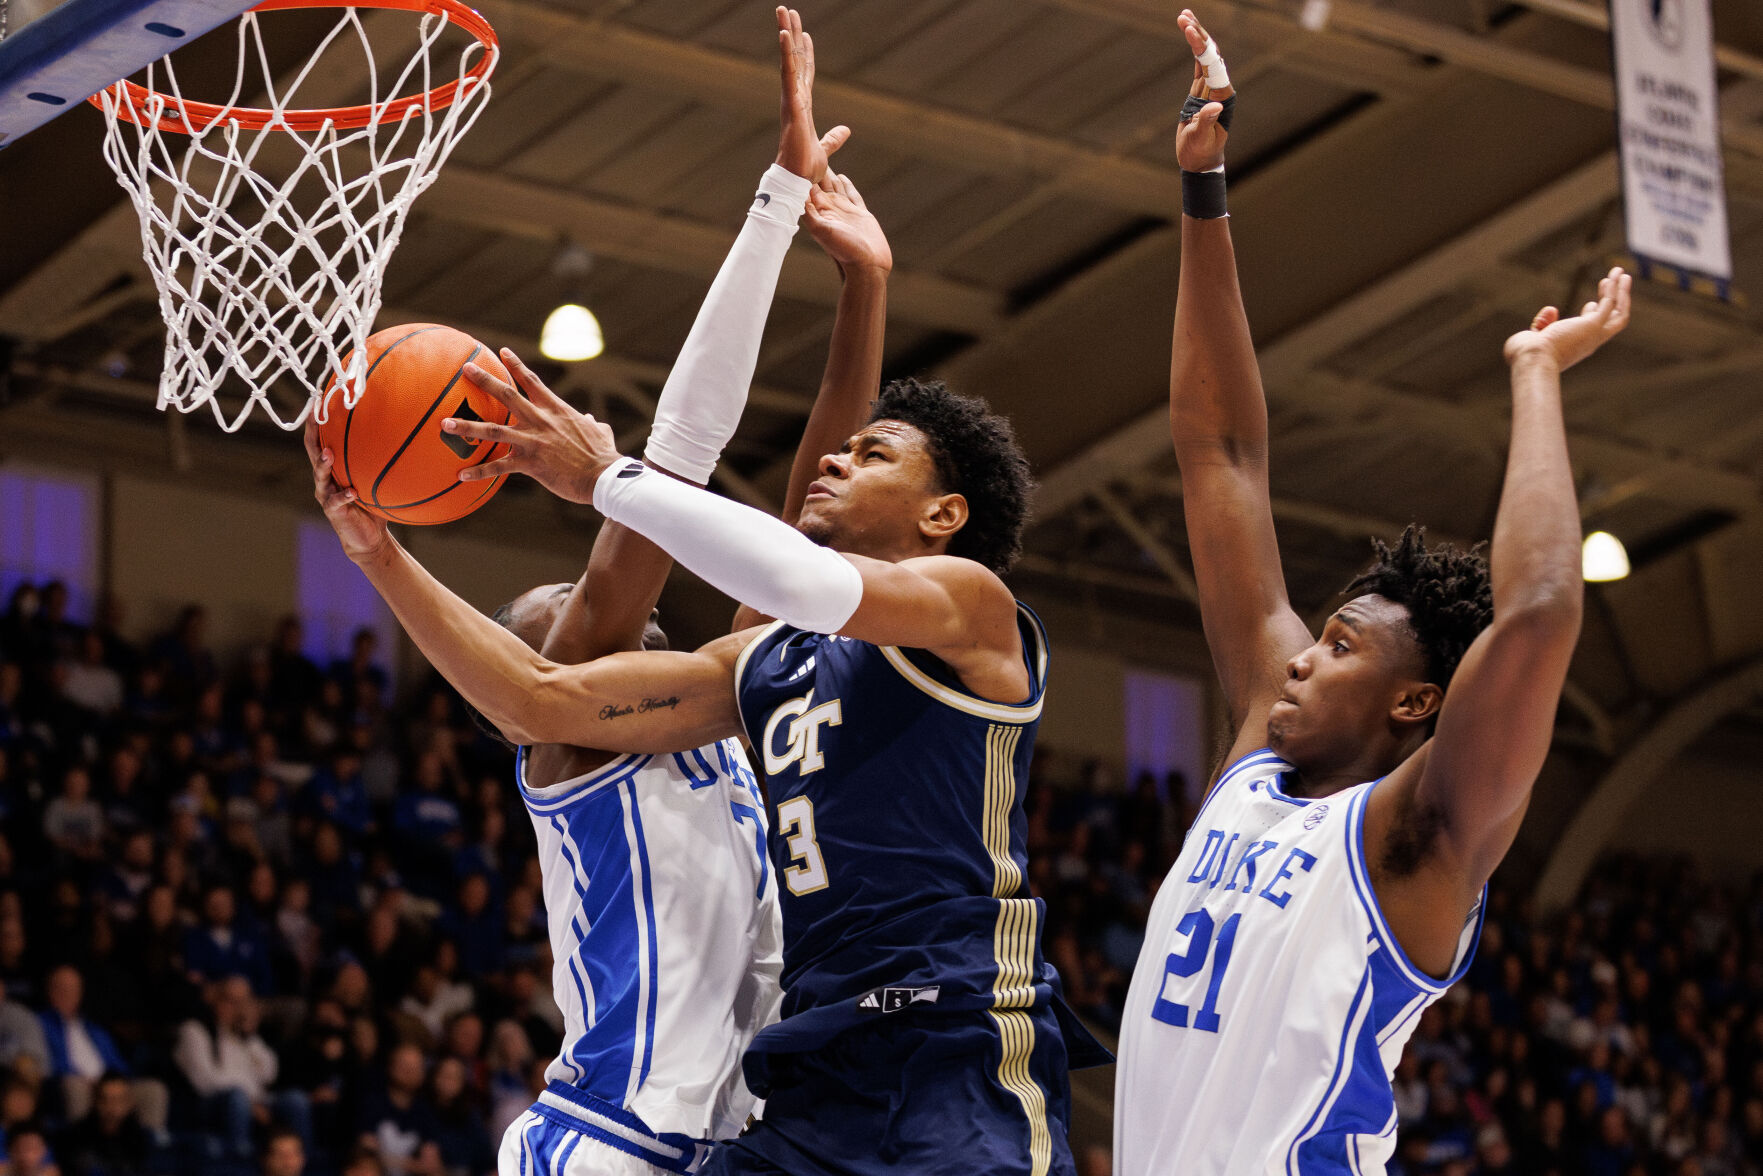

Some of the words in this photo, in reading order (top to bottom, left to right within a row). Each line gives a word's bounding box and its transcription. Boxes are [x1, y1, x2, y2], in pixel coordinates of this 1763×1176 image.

[730, 800, 768, 901] 7
[777, 795, 829, 897] 3
[894, 997, 902, 1008] S
[1151, 907, 1242, 1033] 21
